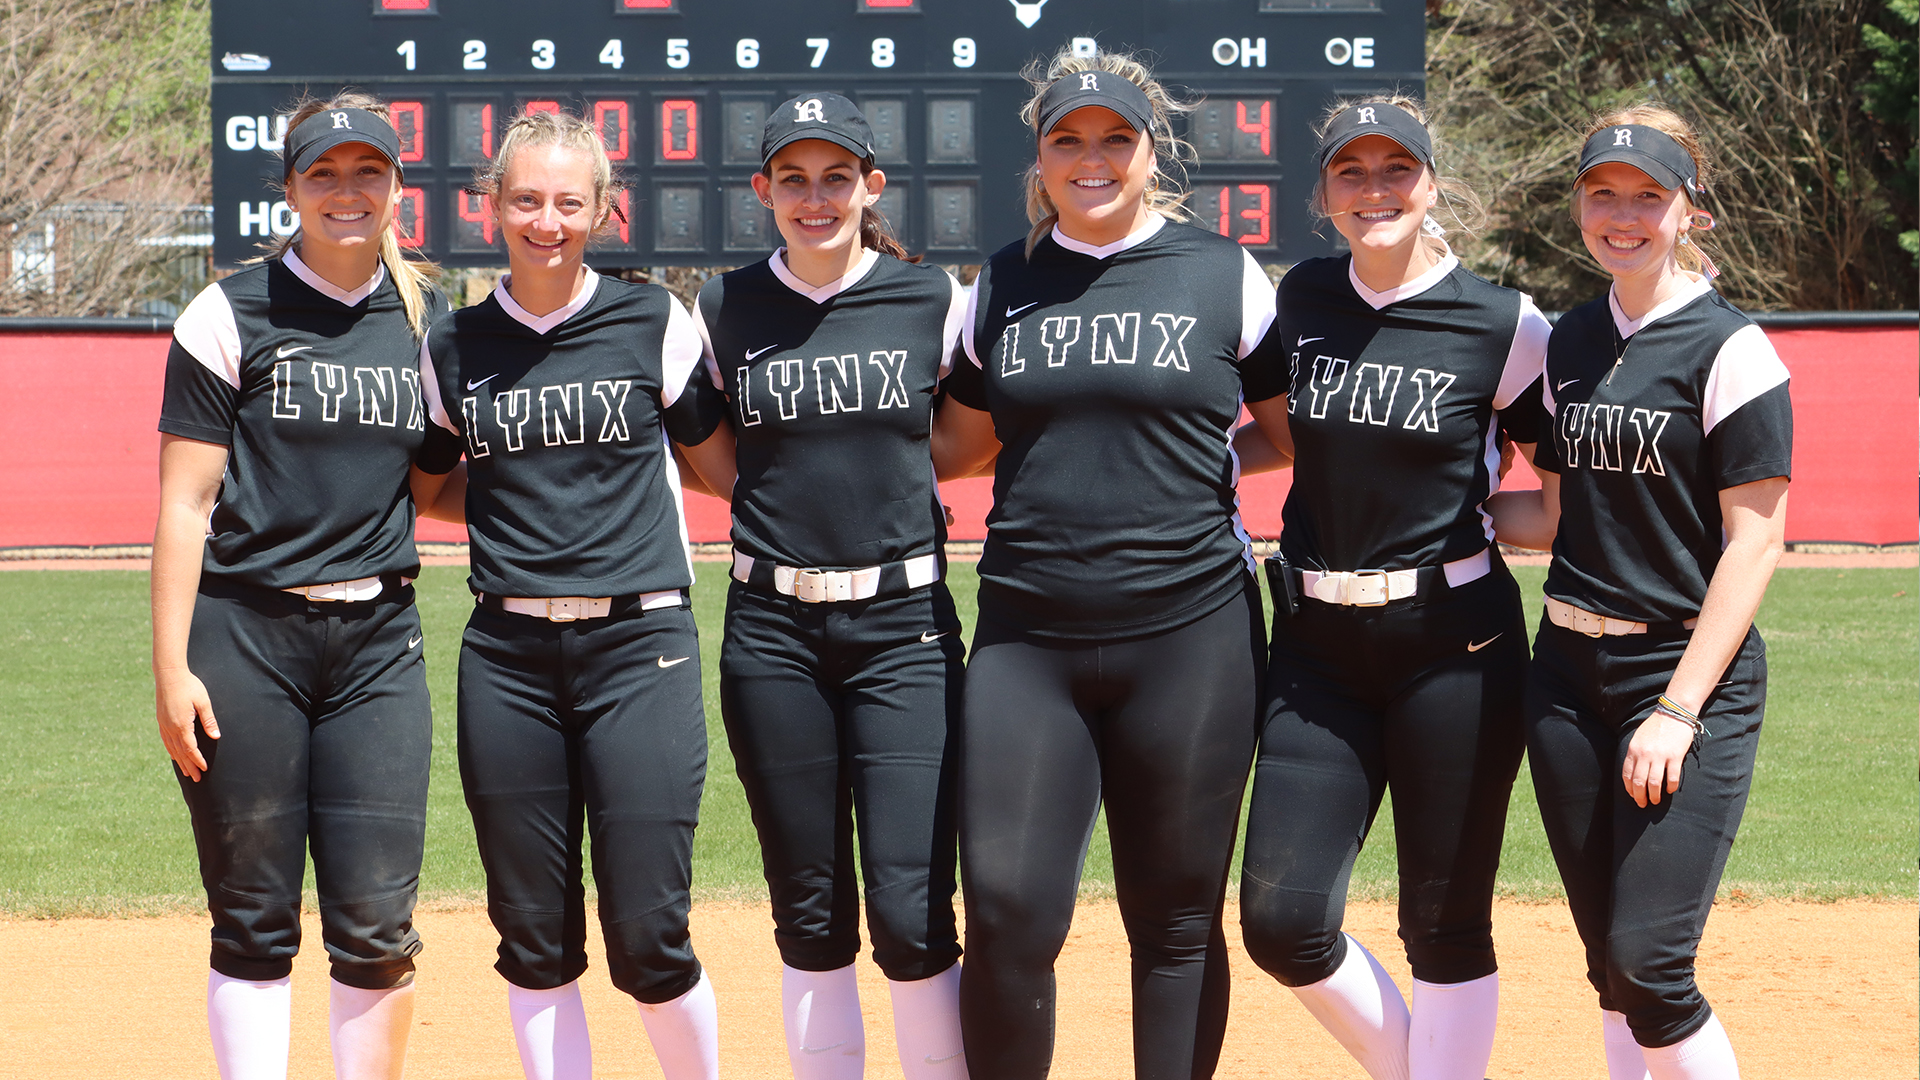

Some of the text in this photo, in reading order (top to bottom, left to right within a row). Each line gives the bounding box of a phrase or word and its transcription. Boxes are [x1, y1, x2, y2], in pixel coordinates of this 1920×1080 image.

[397, 41, 416, 70] 1
[463, 40, 487, 70] 2
[531, 39, 555, 70] 3
[599, 39, 624, 69] 4
[666, 38, 690, 69] 5
[736, 38, 760, 69] 6
[806, 38, 830, 68] 7
[871, 38, 895, 68] 8
[952, 37, 976, 68] 9
[1079, 73, 1100, 92] R
[330, 112, 352, 129] R
[390, 101, 424, 162] 0
[662, 101, 697, 160] 0
[1236, 101, 1271, 156] 4
[794, 98, 828, 124] R
[1357, 107, 1379, 124] R
[1612, 128, 1633, 147] R
[1219, 184, 1271, 244] 13
[1001, 312, 1198, 378] LYNX
[736, 350, 909, 427] LYNX
[461, 380, 632, 459] LYNX
[1561, 403, 1672, 477] YNX
